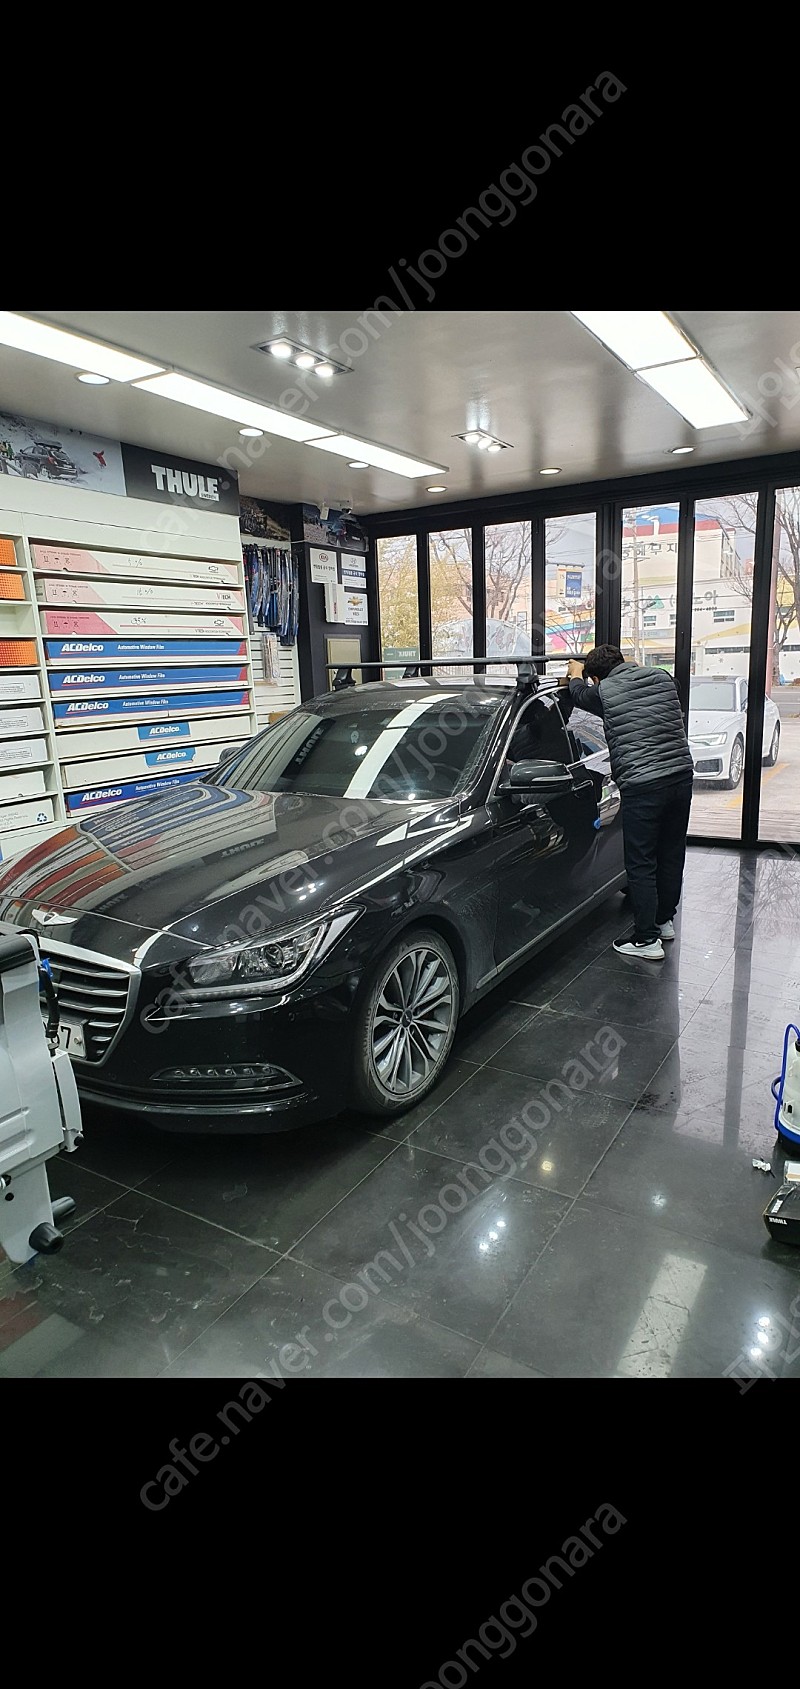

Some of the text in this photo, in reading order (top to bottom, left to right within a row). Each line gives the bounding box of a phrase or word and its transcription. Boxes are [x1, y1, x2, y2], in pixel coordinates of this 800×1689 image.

[151, 464, 219, 499] THULE
[61, 643, 104, 652] ACDelco
[63, 674, 105, 684] ACDelco
[67, 702, 109, 712] ACDelco
[149, 726, 180, 735] ACDelco
[156, 751, 187, 761] ACDelco
[82, 788, 122, 802] ACDelco
[135, 783, 156, 791] Automotive
[156, 780, 171, 788] Window
